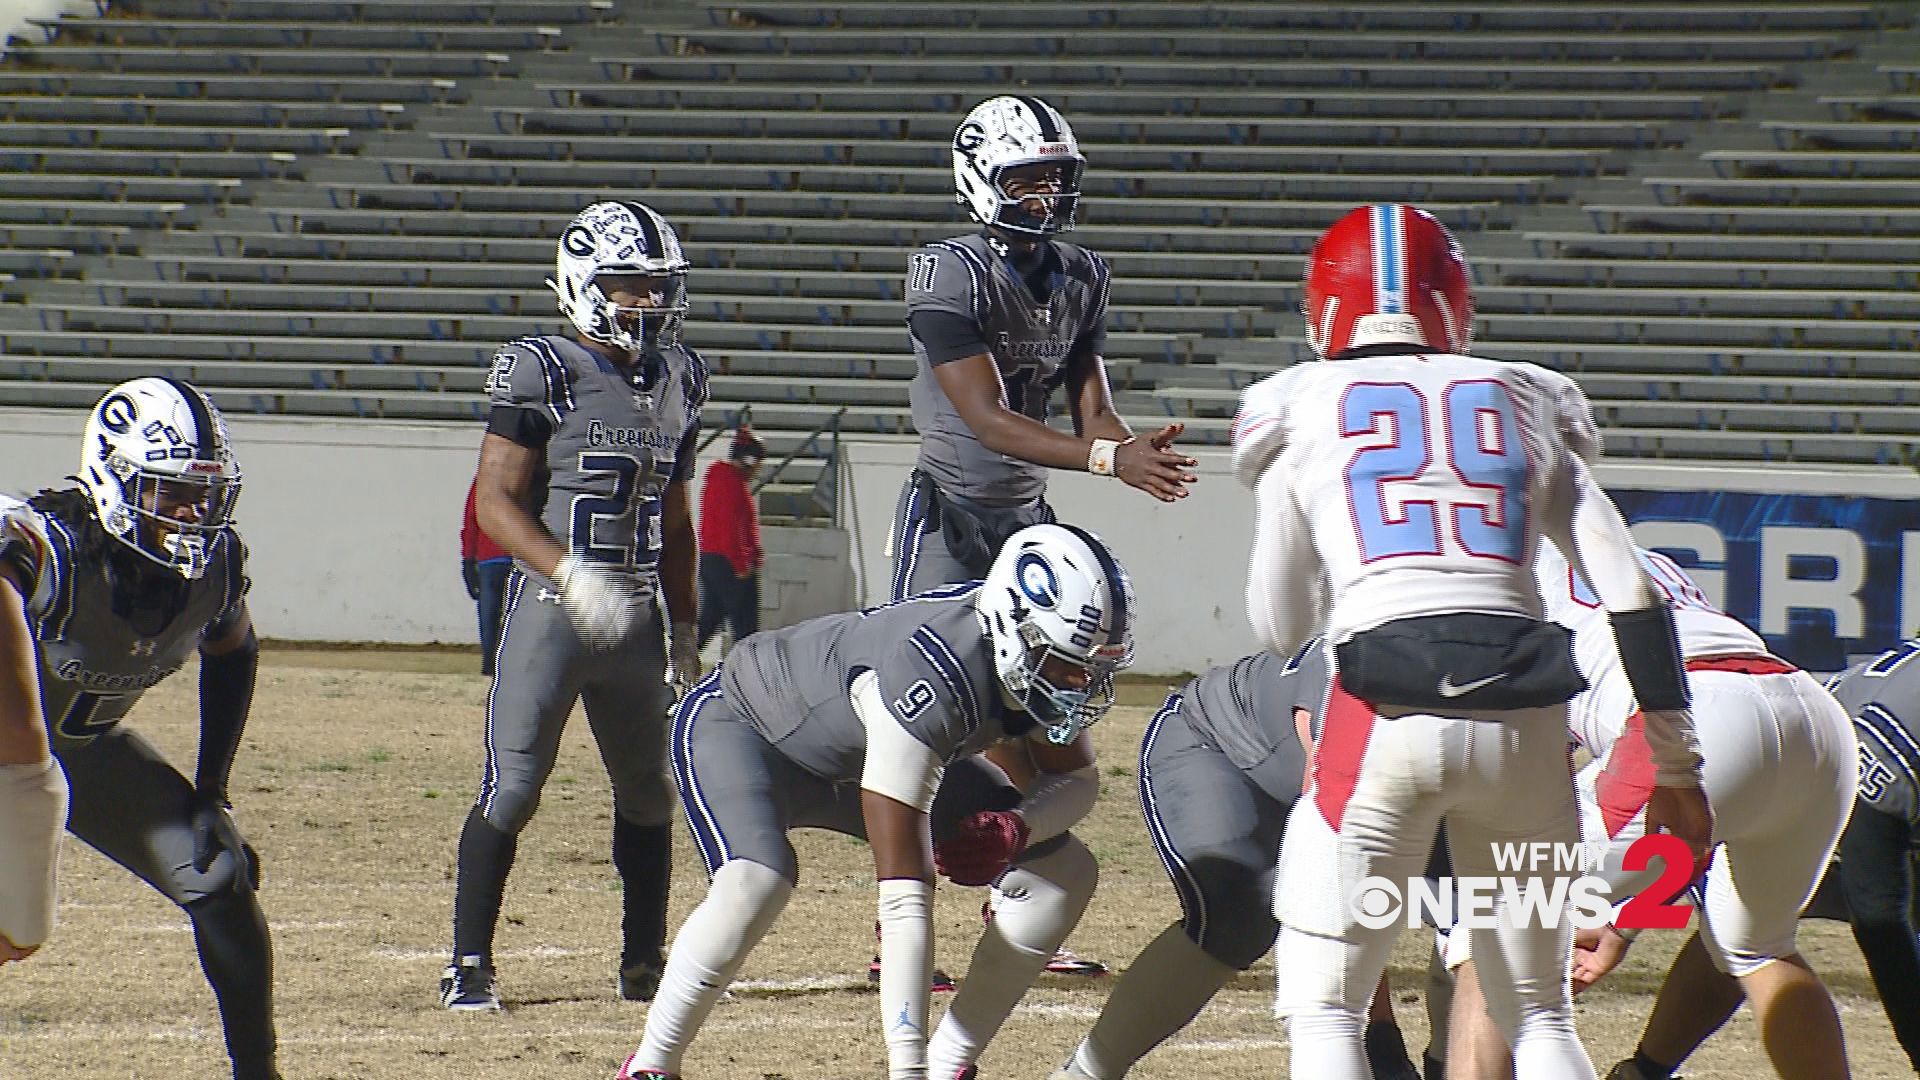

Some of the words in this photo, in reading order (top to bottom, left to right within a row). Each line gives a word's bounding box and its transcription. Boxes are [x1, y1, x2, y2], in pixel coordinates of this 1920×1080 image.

[911, 253, 940, 293] 11
[573, 451, 676, 566] 22
[1336, 379, 1533, 566] 29
[893, 679, 937, 722] 9
